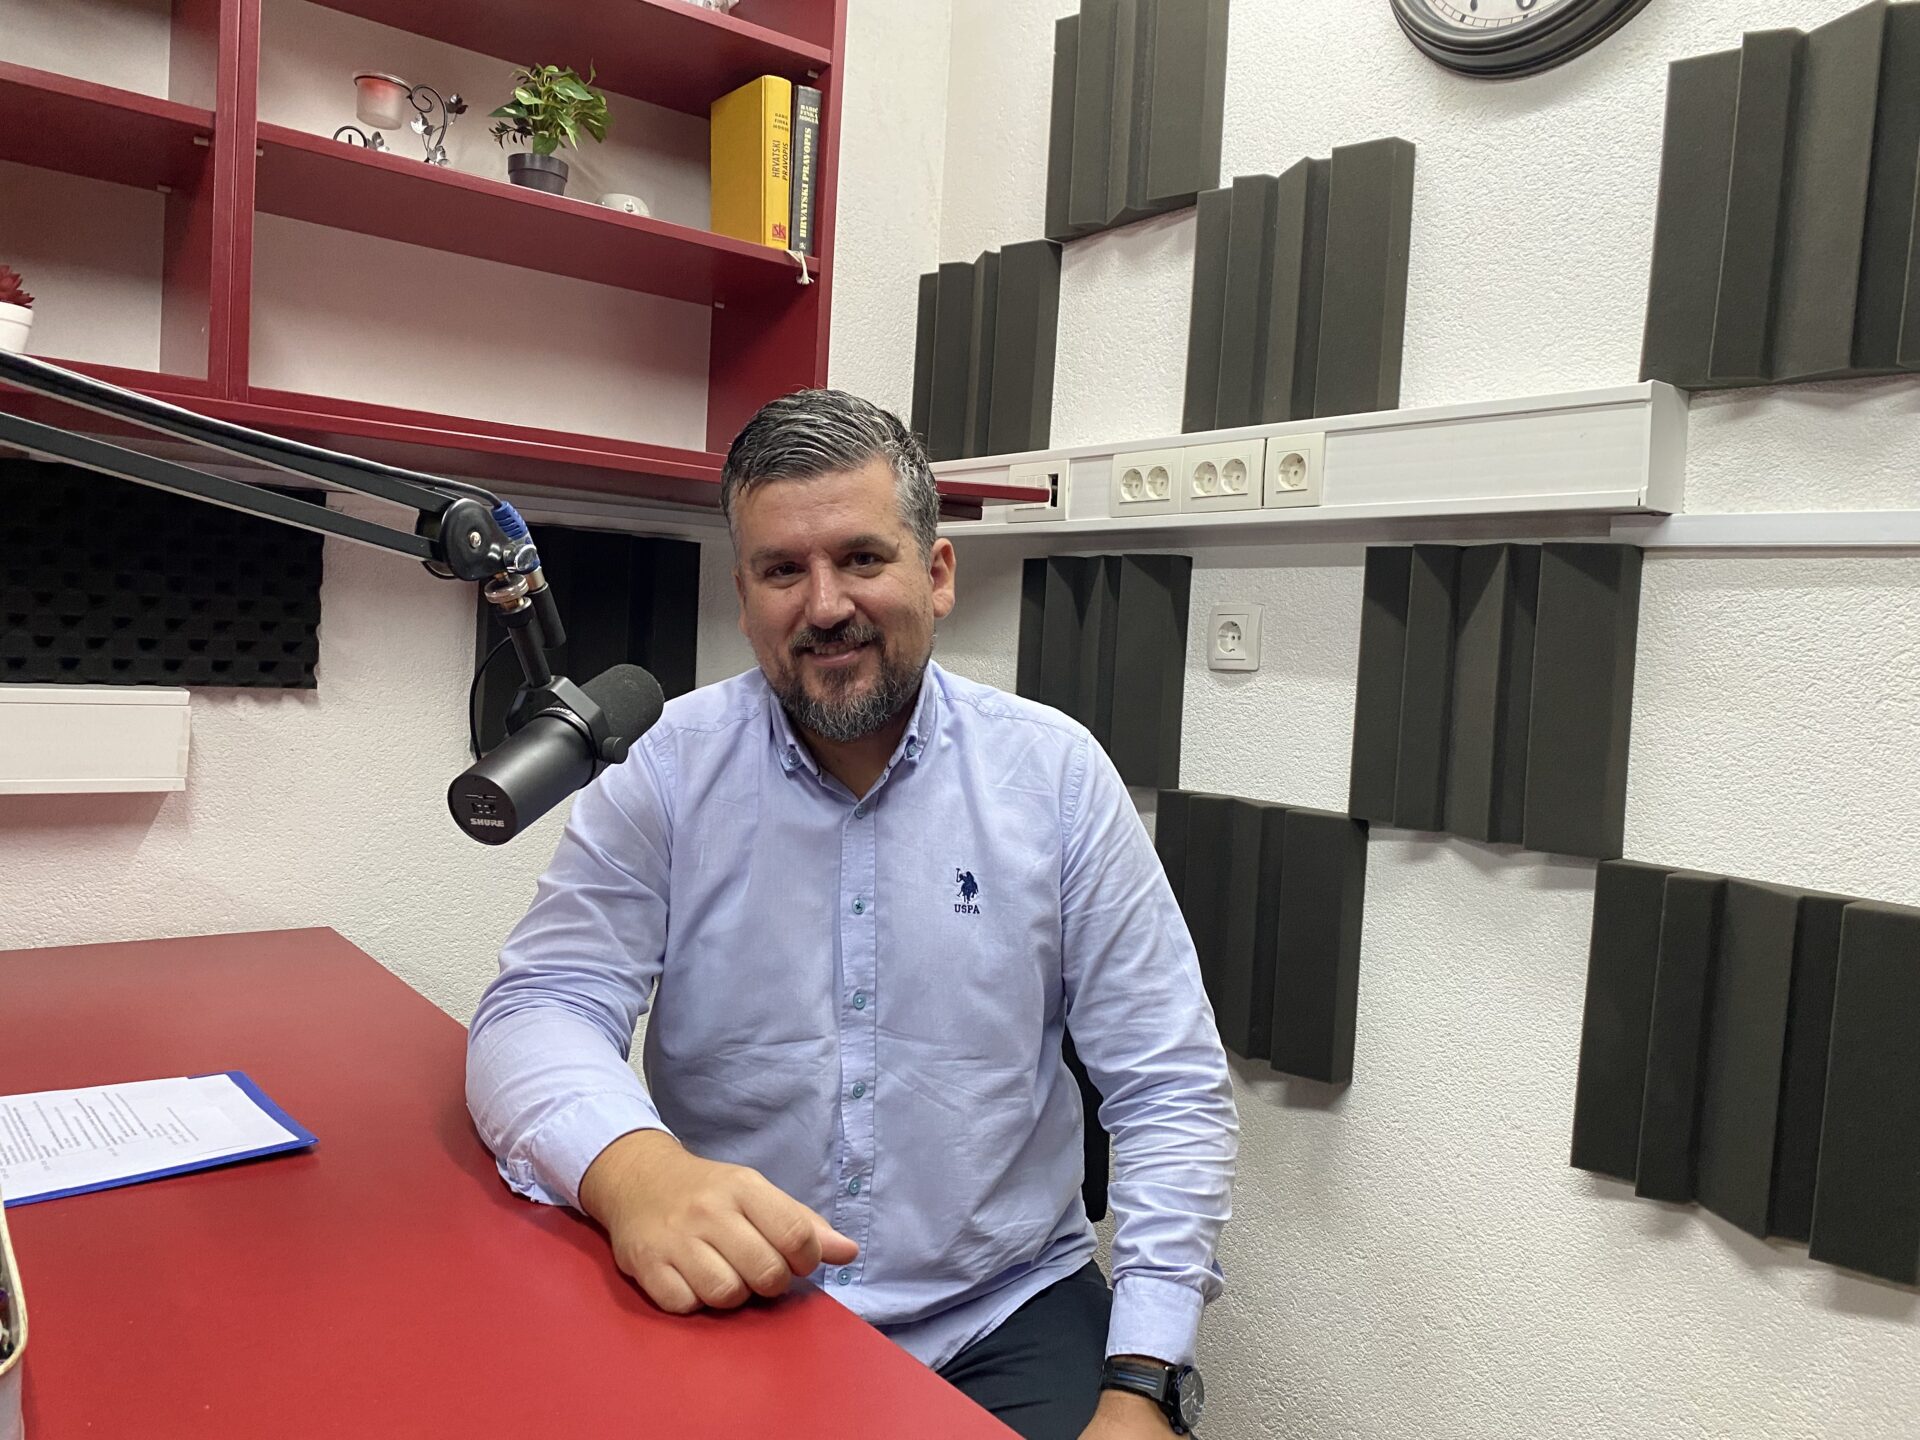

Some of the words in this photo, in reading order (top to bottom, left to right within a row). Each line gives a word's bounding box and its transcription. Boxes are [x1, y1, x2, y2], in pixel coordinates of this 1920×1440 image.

[772, 140, 780, 178] HRVATSKI
[802, 127, 811, 181] PRAVOPIS
[799, 183, 809, 238] HRVATSKI
[470, 818, 505, 827] SHURE
[954, 904, 980, 914] USPA
